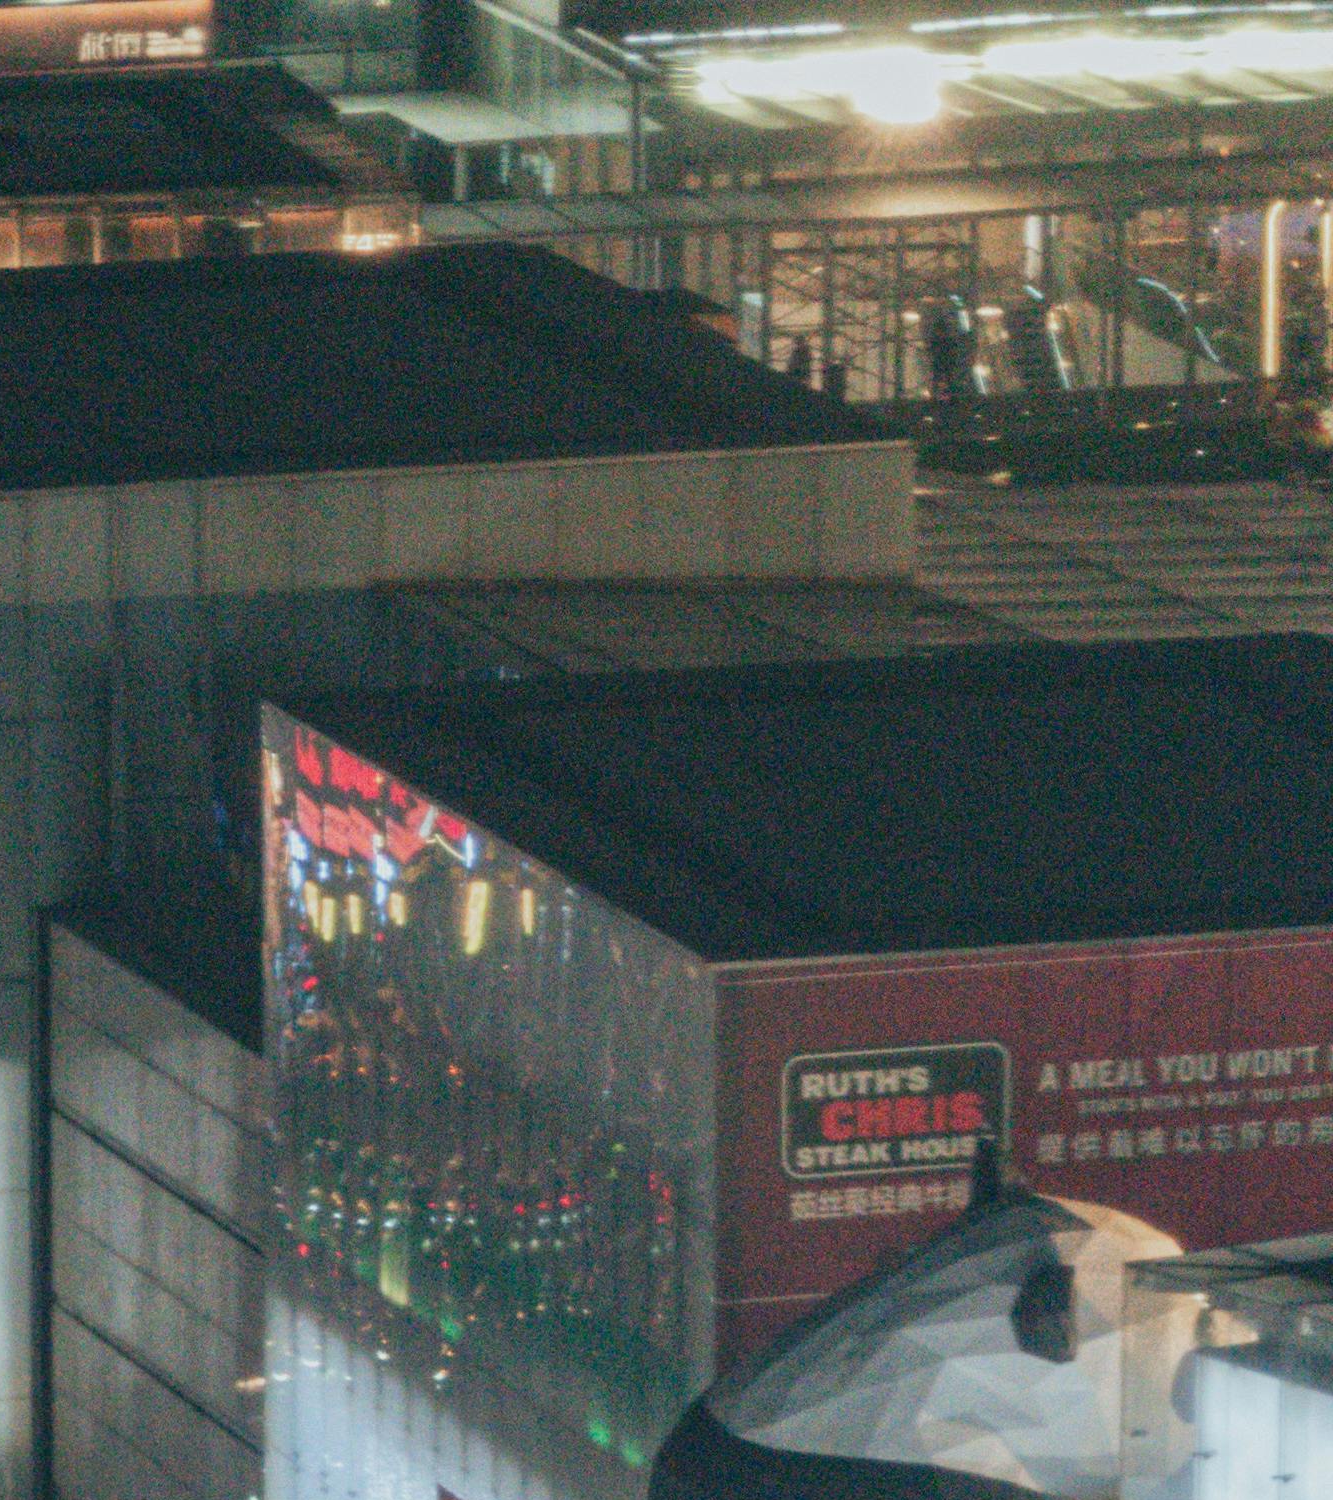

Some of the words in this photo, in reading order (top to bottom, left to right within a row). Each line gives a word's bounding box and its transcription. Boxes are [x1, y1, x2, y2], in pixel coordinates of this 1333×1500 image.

[801, 1066, 930, 1099] RUTH'S
[1037, 1062, 1059, 1091] A
[1069, 1059, 1145, 1090] MEAL
[1157, 1052, 1219, 1083] YOU
[1227, 1045, 1319, 1080] WON'T
[821, 1091, 984, 1141] CHRIS
[795, 1142, 892, 1169] STEAK
[901, 1134, 983, 1162] HOUS
